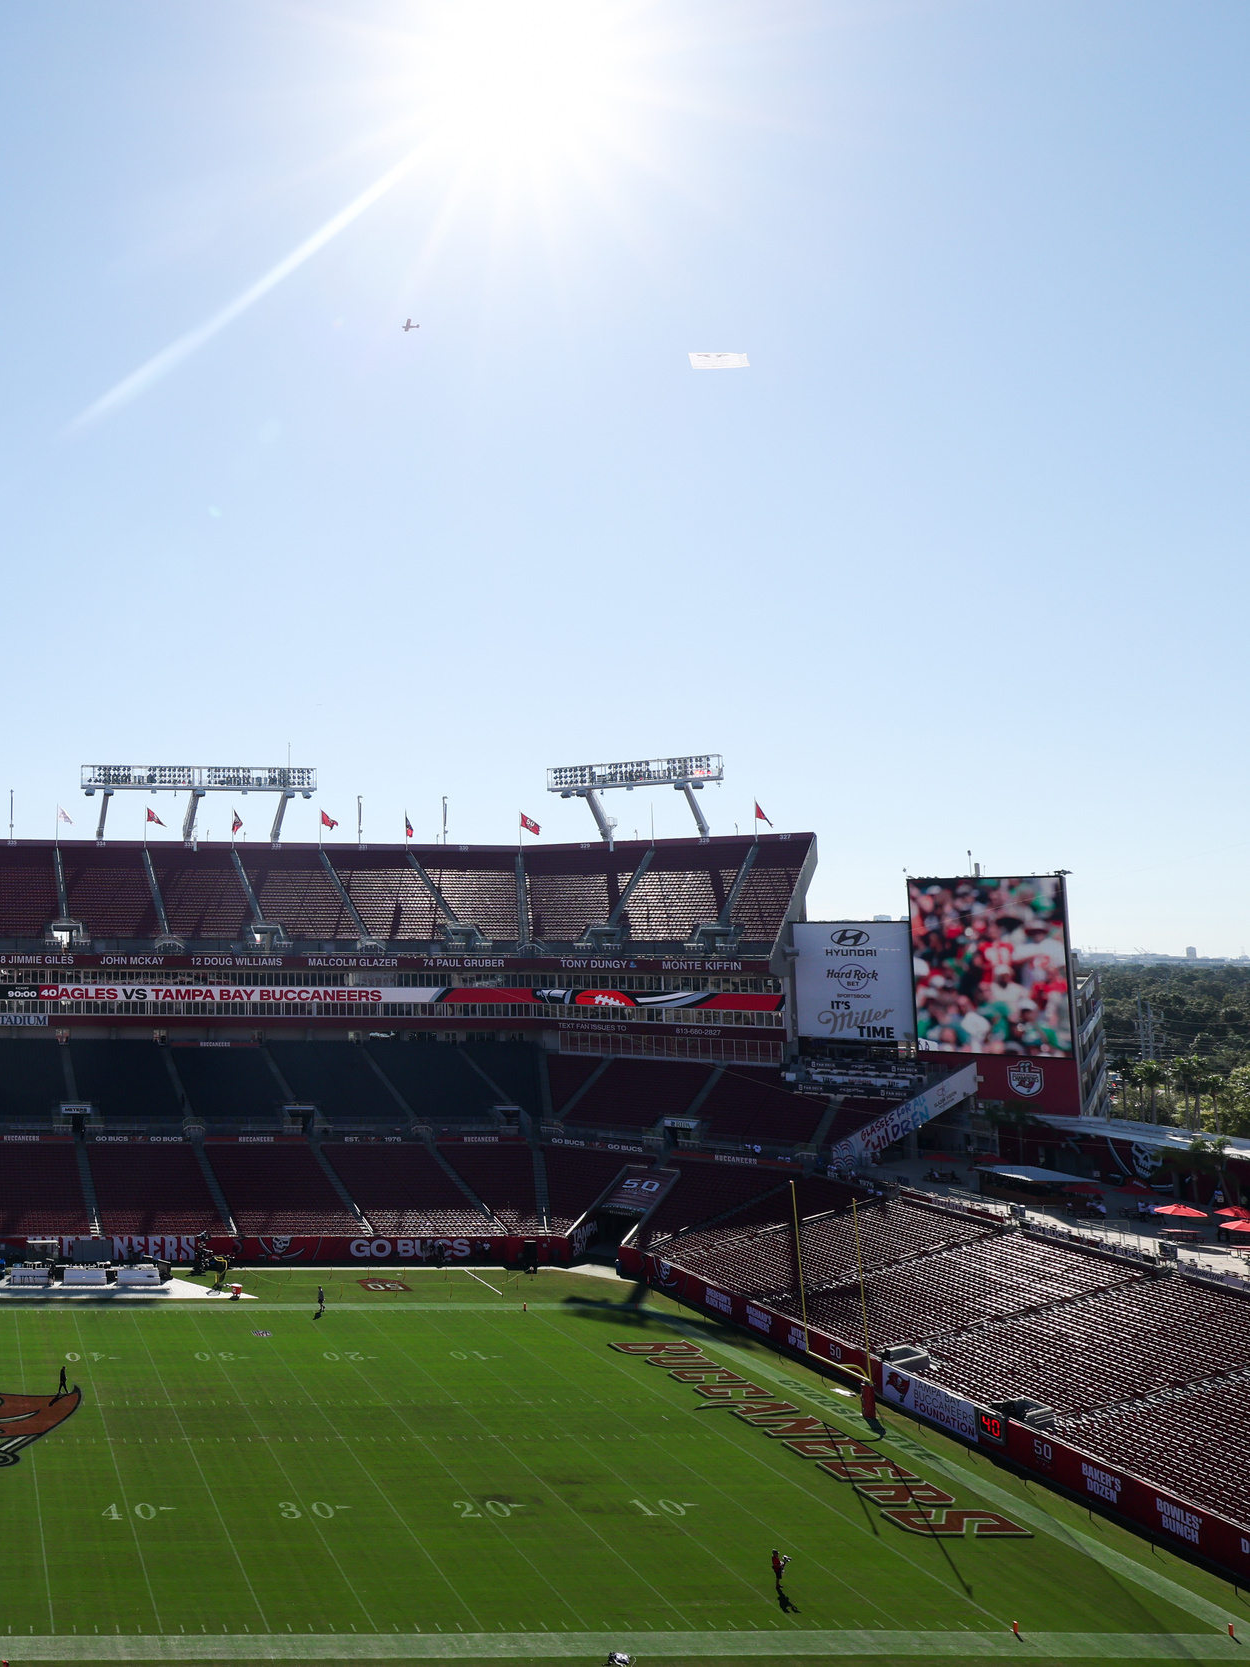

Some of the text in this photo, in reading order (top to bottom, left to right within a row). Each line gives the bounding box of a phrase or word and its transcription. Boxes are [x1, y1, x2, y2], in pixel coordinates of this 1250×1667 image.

[8, 955, 39, 964] JIMMIE
[46, 956, 74, 965] GILES
[100, 956, 164, 965] JOHN MCKAY
[191, 957, 283, 966] 12 DOUG WILLIAMS
[825, 949, 877, 957] HYUNDAI
[308, 958, 398, 967] MALCOLM GLAZER
[423, 959, 505, 967] 74 PAUL GRUBER
[560, 960, 627, 969] TONY DUNGY
[662, 961, 742, 971] MONTE KIFFIN
[826, 969, 878, 981] Hard Rock
[41, 989, 57, 997] 40
[58, 988, 382, 1001] AGLES VS TAMPA BAY BUCCANEERS
[831, 1001, 851, 1010] IT'S
[818, 1007, 895, 1034] Miller
[676, 1028, 722, 1036] 813-680-2827
[858, 1026, 894, 1039] TIME
[860, 1113, 895, 1142] GLASSES
[896, 1102, 912, 1117] FOR
[913, 1095, 926, 1109] ALL
[566, 1138, 585, 1146] BUCS
[623, 1144, 643, 1153] BUCS
[622, 1179, 660, 1192] 50
[572, 1220, 598, 1242] TAMPA
[350, 1239, 471, 1257] GO BUCS
[829, 1343, 841, 1359] 50
[914, 1379, 960, 1407] TAMPA BAY
[913, 1390, 975, 1426] BUCCANEERS
[914, 1400, 975, 1437] FOUNDATION
[982, 1415, 1000, 1437] 40
[608, 1339, 1031, 1535] BUCCANEERS
[1033, 1439, 1052, 1459] 50
[1081, 1462, 1122, 1492] BAKER'S
[1086, 1478, 1117, 1504] DOZEN
[101, 1502, 156, 1521] 40
[278, 1501, 335, 1520] 30
[452, 1500, 511, 1519] 20
[628, 1498, 687, 1518] 10
[1156, 1497, 1203, 1530] BOWLES'
[1161, 1514, 1200, 1545] BUNCH
